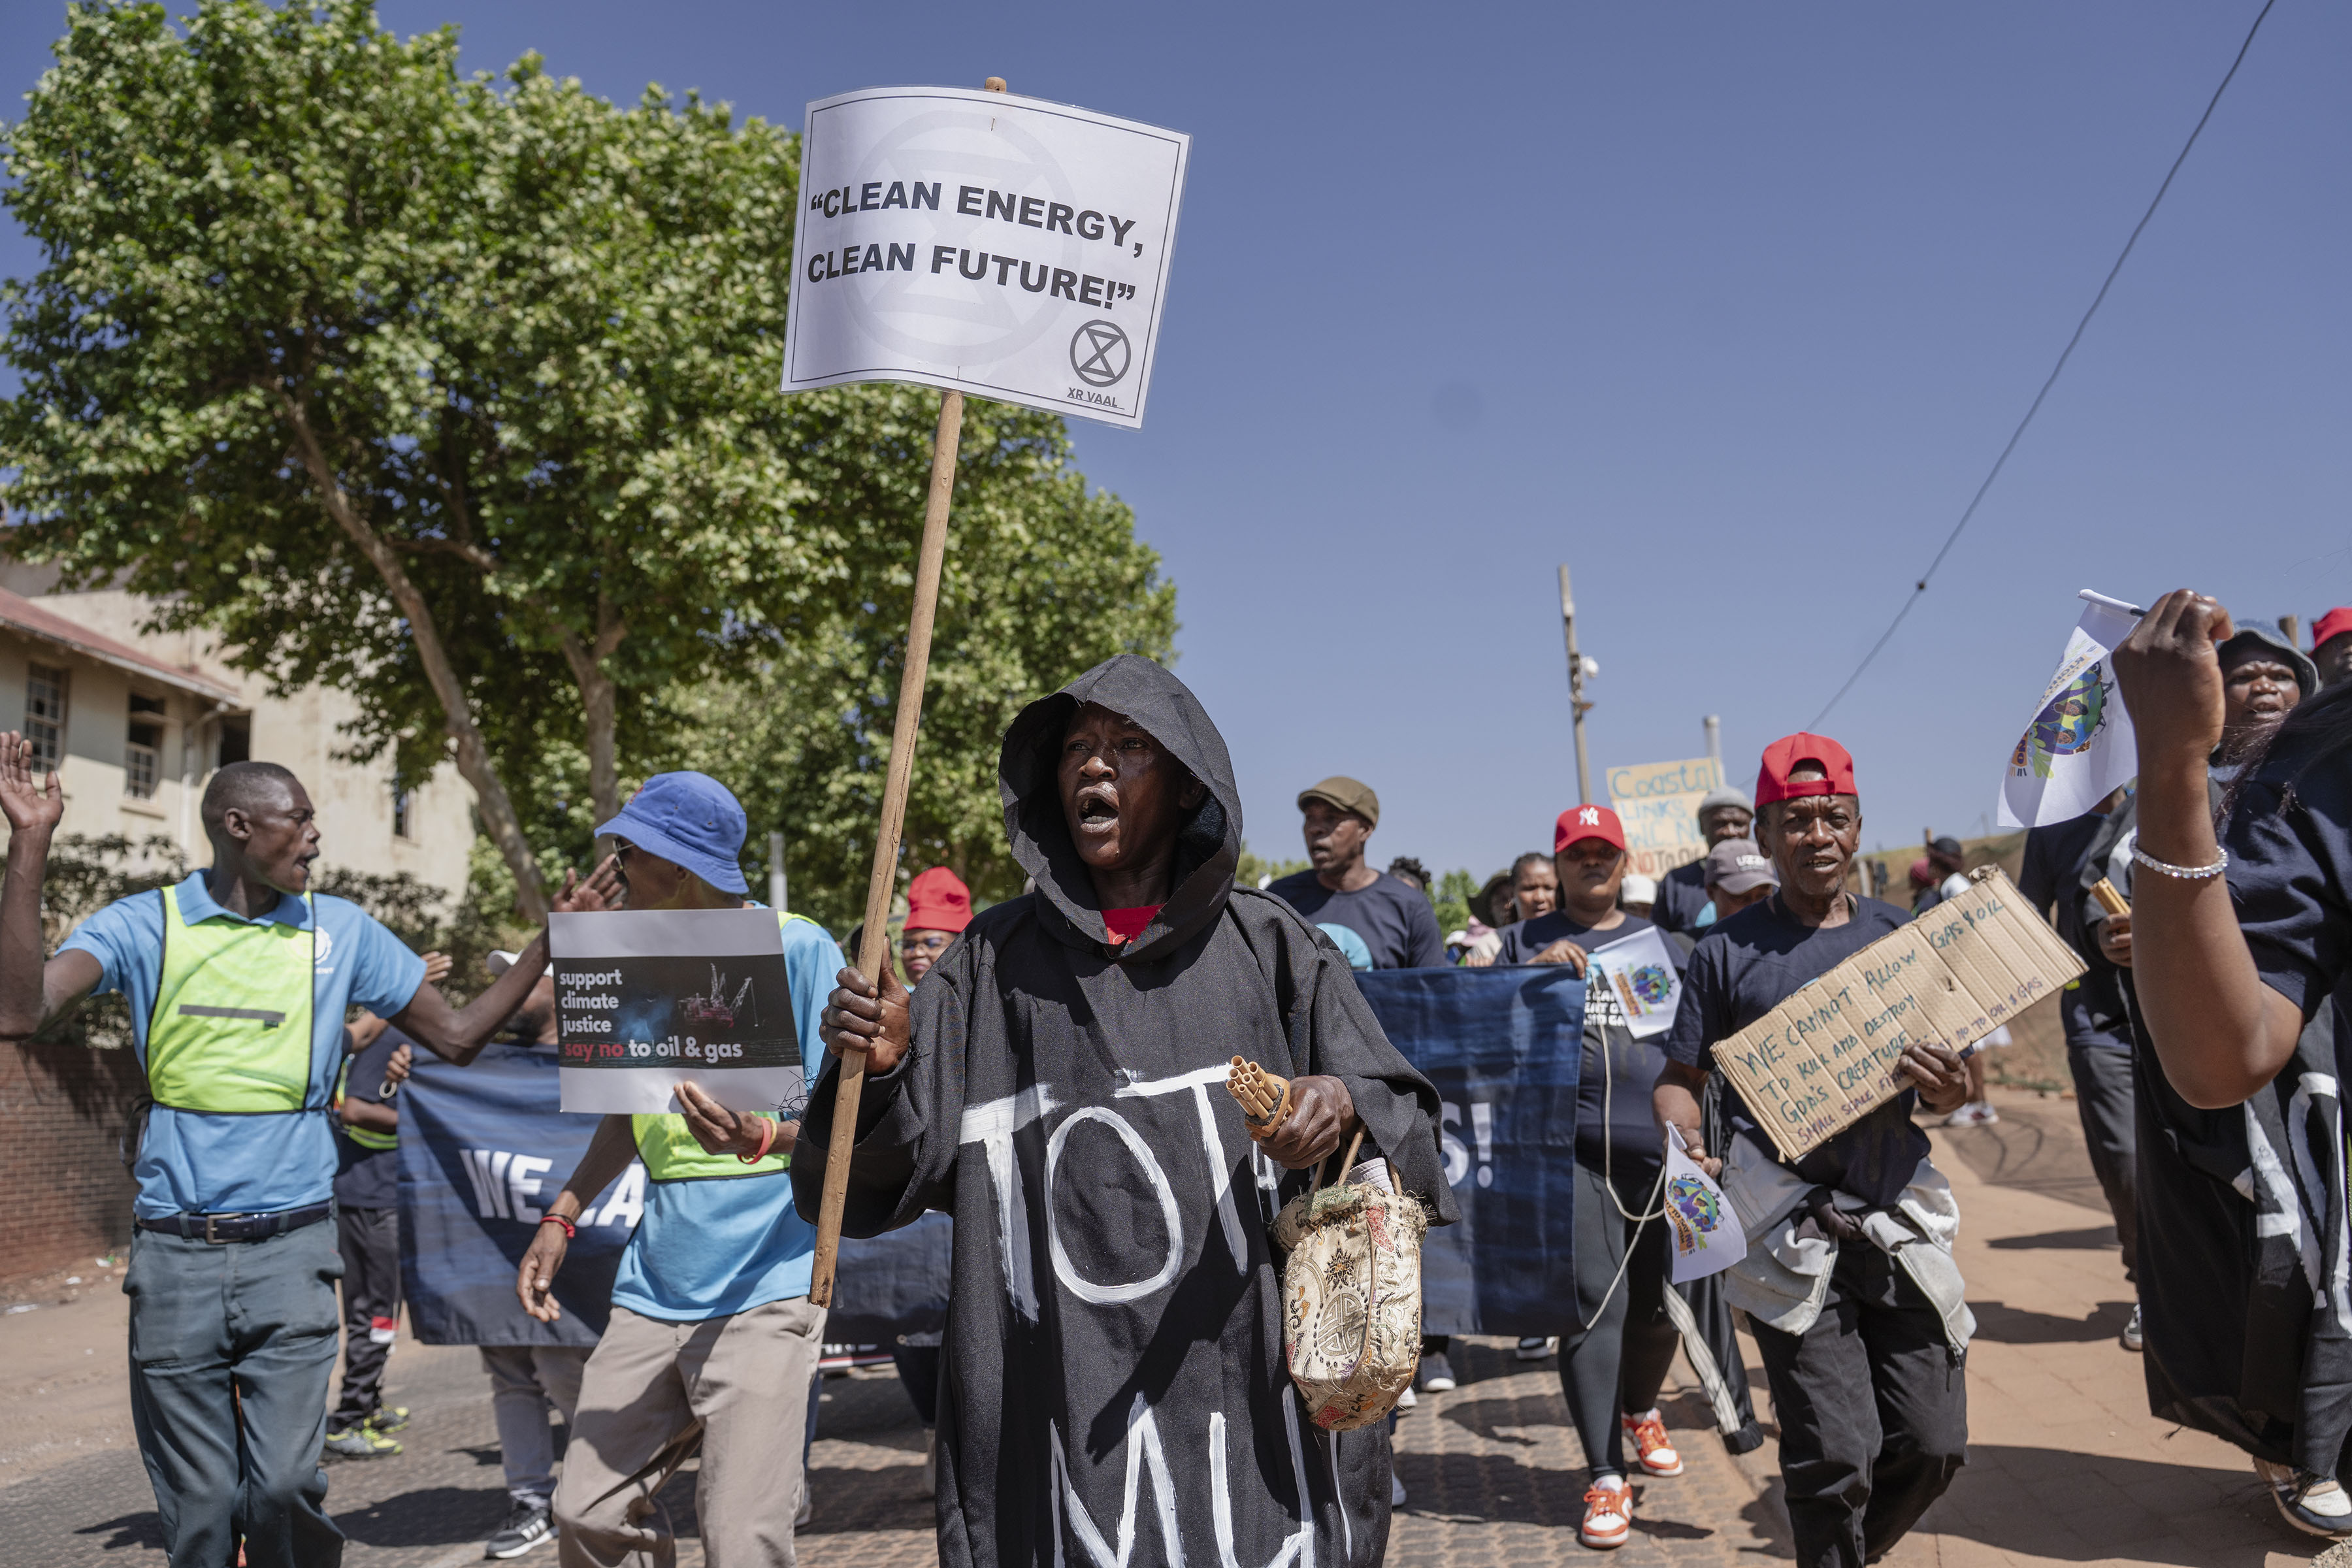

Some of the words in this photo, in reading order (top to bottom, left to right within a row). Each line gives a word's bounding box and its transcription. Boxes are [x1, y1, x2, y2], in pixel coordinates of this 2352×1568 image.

[811, 181, 941, 219] “CLEAN
[956, 185, 1143, 259] ENERGY,
[808, 242, 915, 283] CLEAN
[930, 245, 1135, 310] FUTURE!”
[1067, 387, 1083, 399] XR
[1087, 391, 1117, 407] VAAL
[560, 969, 623, 990] support
[561, 990, 619, 1009] climate
[1734, 1034, 1785, 1076] WE
[1786, 987, 1852, 1047] CANNOT
[1865, 949, 1916, 995] ALLOW
[1930, 921, 1964, 949] GAS
[1976, 899, 2004, 920] OIL
[562, 1015, 612, 1037] justice
[564, 1043, 593, 1063] say
[599, 1044, 624, 1058] no
[629, 1039, 651, 1058] to
[656, 1036, 680, 1057] oil
[685, 1036, 701, 1057] &
[704, 1043, 743, 1064] gas
[1759, 1077, 1790, 1100] TO
[1797, 1054, 1830, 1079] KILL
[1864, 994, 1915, 1037] DESTROY
[1797, 1115, 1836, 1145] SMALL
[1841, 1090, 1874, 1115] SCALE
[1955, 1026, 1969, 1041] NO
[1971, 1017, 1986, 1030] TO
[1990, 1004, 2007, 1017] OIL
[2017, 977, 2043, 998] GAS
[459, 1149, 553, 1225] WE
